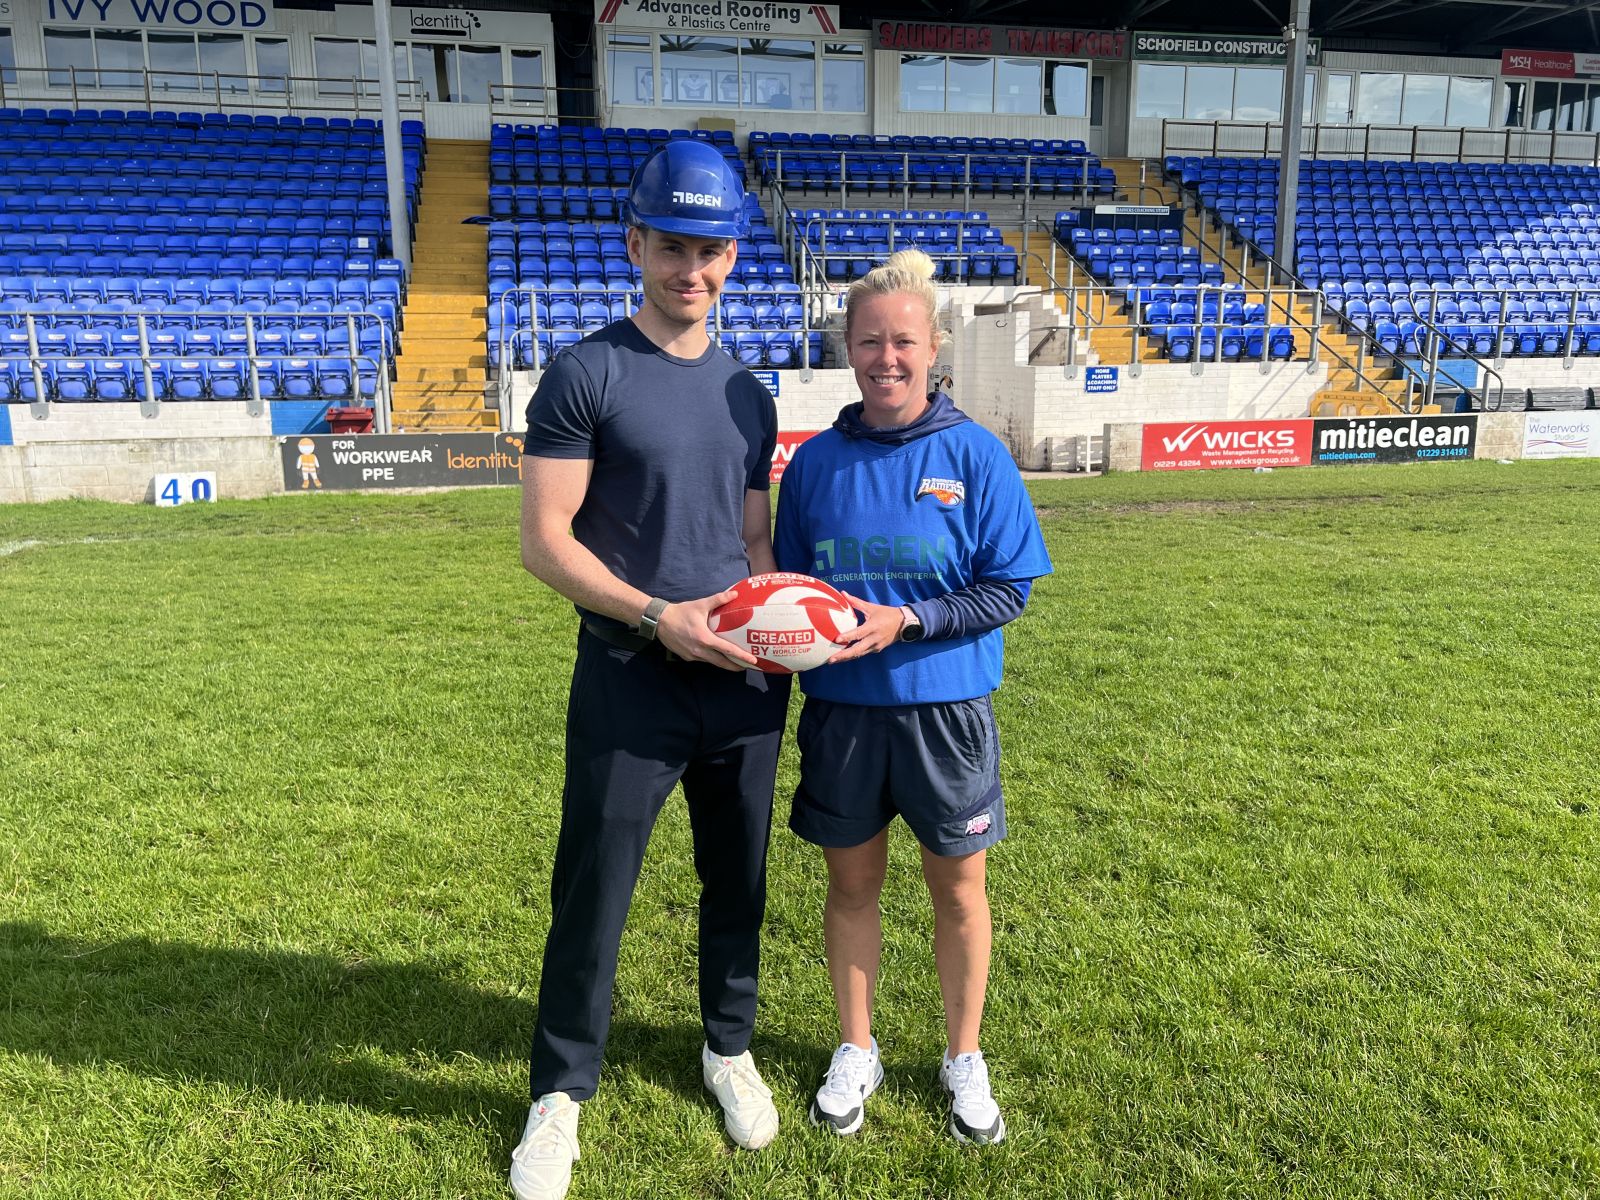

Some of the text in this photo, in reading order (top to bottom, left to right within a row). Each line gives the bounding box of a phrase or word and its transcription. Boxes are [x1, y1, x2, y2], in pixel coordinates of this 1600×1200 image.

[48, 0, 266, 27] IVY WOOD
[637, 0, 801, 23] Advanced Roofing
[410, 9, 471, 39] Identity
[667, 15, 771, 31] & Plastics Centre
[879, 22, 1126, 58] SAUNDERS TRANSPORT
[1138, 38, 1316, 56] SCHOFIELD CONSTRUCN
[1534, 59, 1572, 70] Healthcare
[685, 192, 722, 208] BGEN
[1319, 420, 1470, 450] mitieclean
[1529, 423, 1590, 434] Waterworks
[333, 441, 355, 450] FOR
[1203, 430, 1295, 450] WICKS
[333, 450, 432, 464] WORKWEAR
[1319, 452, 1376, 460] mitieclean.com
[1441, 448, 1468, 456] 314191
[447, 449, 522, 480] Identity
[1210, 456, 1301, 467] www.wicksgroup.co.uk
[363, 468, 394, 481] PPE
[917, 478, 965, 501] RAIDERS
[839, 535, 946, 568] BGEN
[752, 580, 768, 588] BY
[832, 573, 884, 583] GENERATION
[885, 572, 943, 581] ENGINEERING
[750, 632, 812, 643] CREATED
[751, 645, 769, 656] BY
